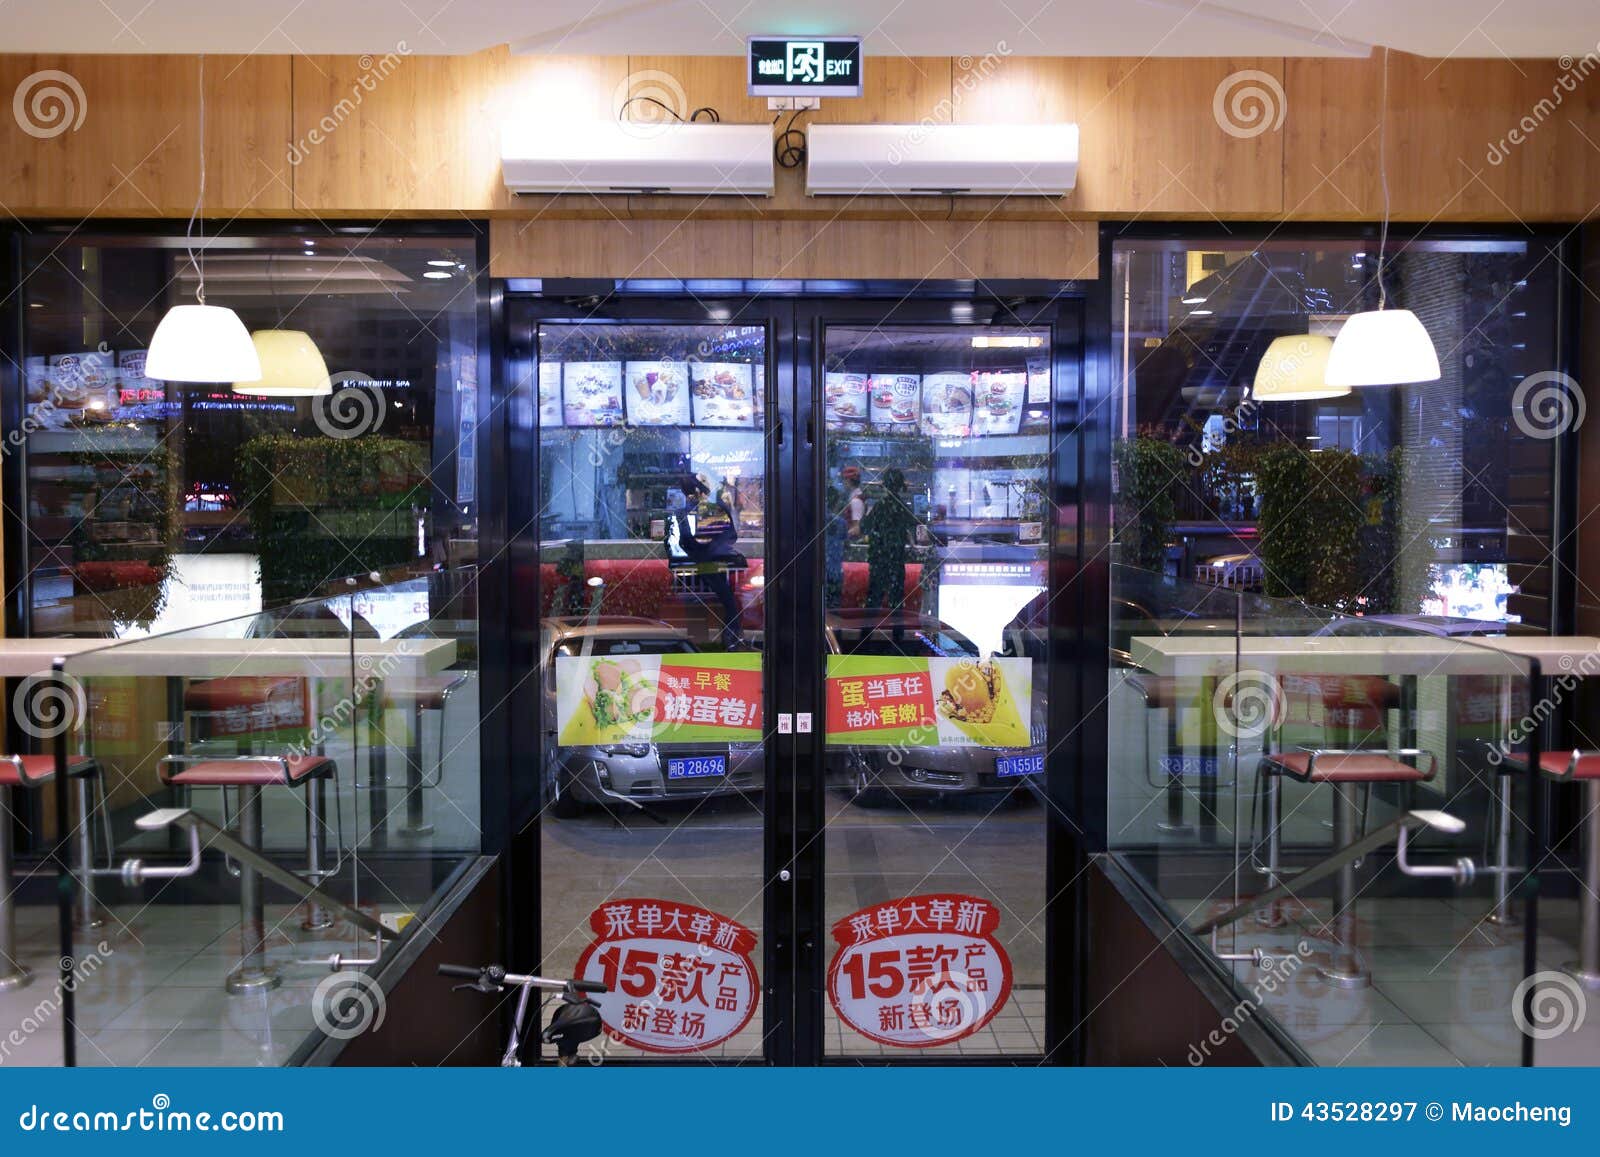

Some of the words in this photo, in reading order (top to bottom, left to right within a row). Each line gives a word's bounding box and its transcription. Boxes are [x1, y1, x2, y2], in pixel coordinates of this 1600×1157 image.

[826, 59, 852, 75] EXIT
[688, 759, 724, 775] 28696
[603, 904, 741, 950] 菜单大革新
[849, 899, 988, 943] 菜单大革新
[715, 961, 743, 1013] 产品
[964, 943, 989, 993] 产品
[623, 1003, 706, 1040] 新登场
[879, 999, 962, 1032] 新登场
